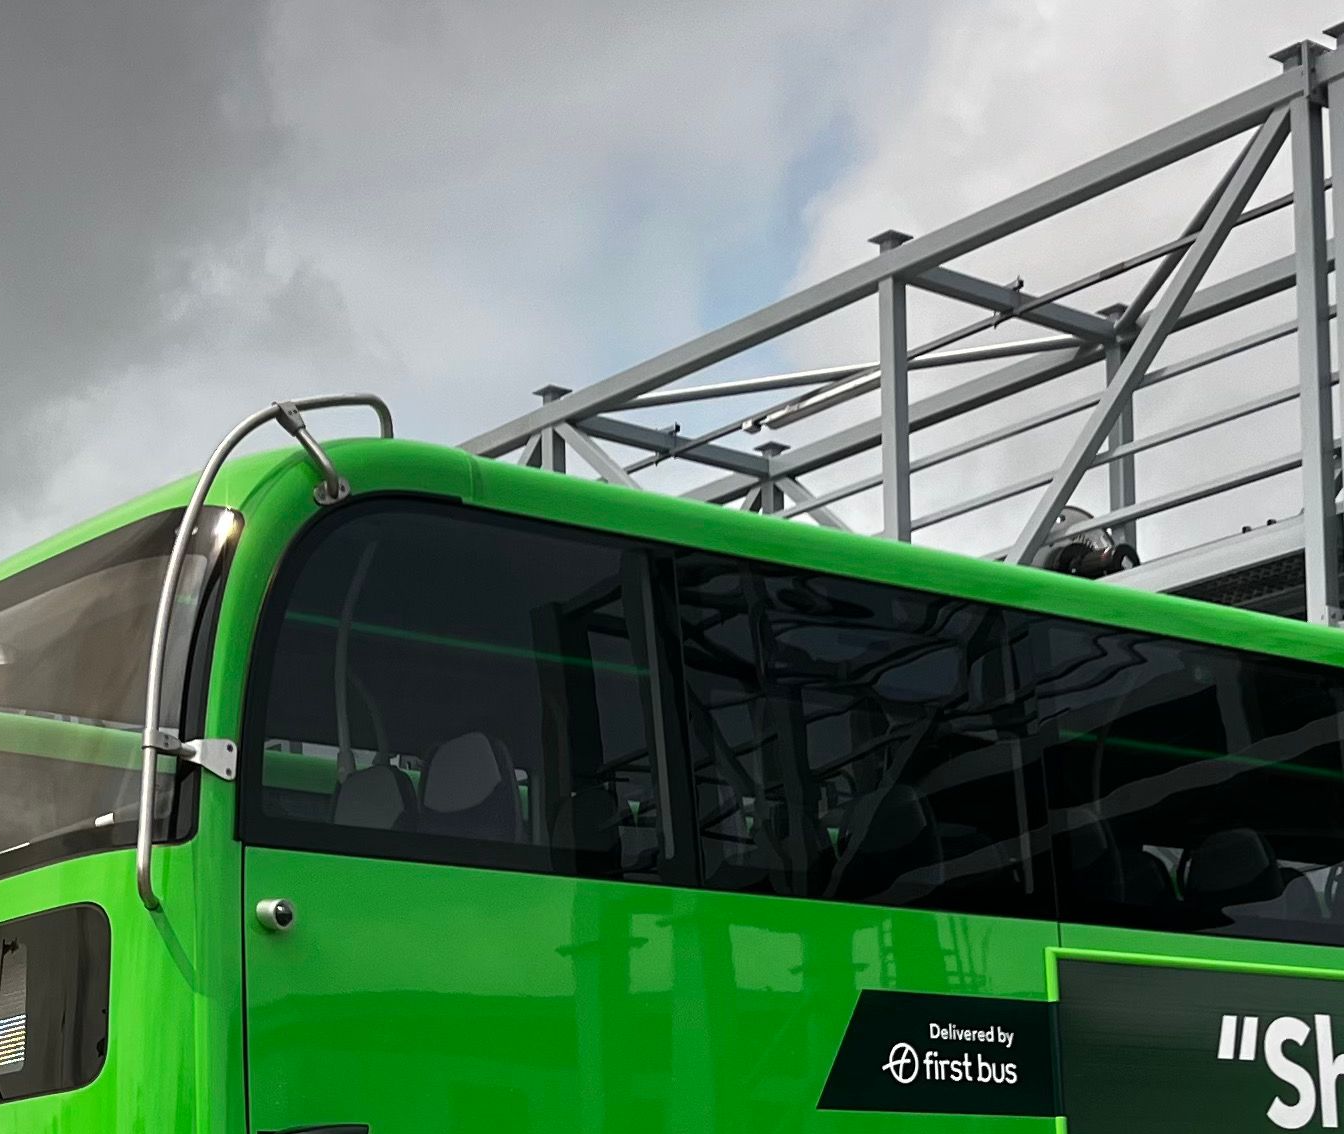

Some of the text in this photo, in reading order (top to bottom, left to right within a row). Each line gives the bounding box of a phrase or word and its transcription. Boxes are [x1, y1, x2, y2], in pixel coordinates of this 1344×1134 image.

[929, 1023, 1014, 1048] Delivered by
[924, 1051, 1017, 1084] first bus
